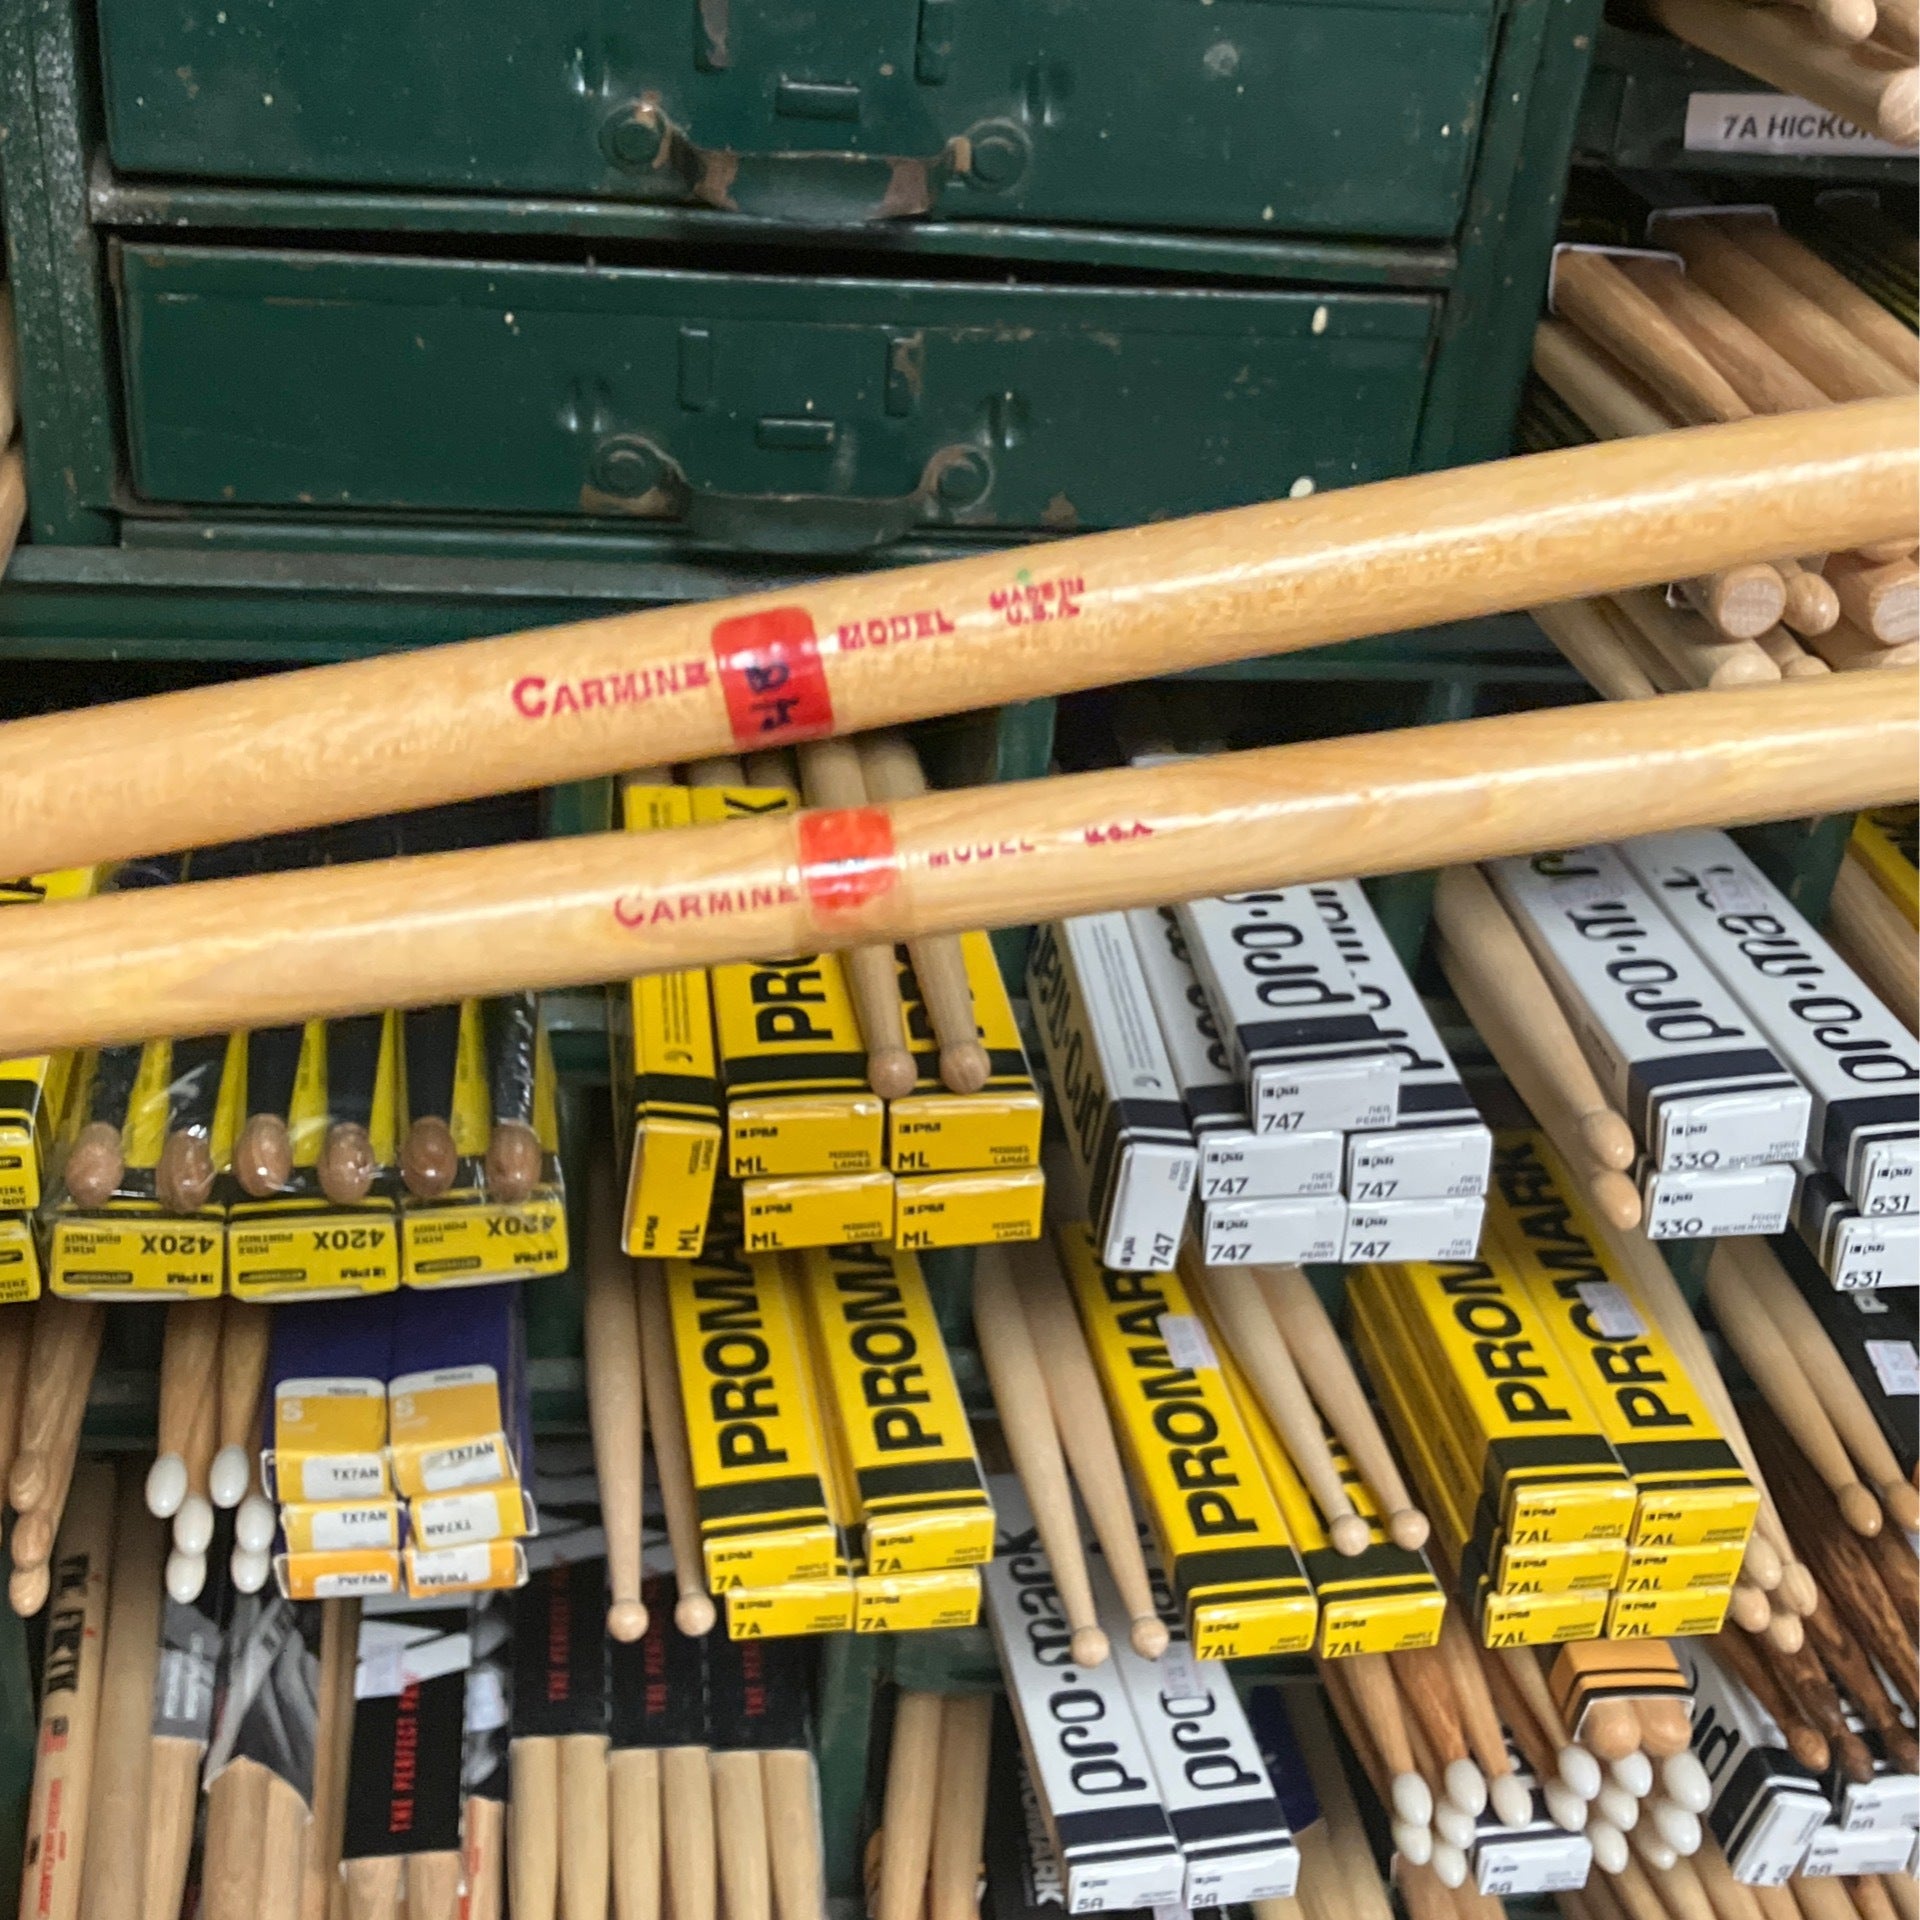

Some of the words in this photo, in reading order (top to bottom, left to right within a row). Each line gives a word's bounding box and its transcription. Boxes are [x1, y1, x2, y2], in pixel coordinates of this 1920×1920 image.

[1723, 115, 1758, 138] 7A
[1767, 114, 1876, 138] HICKO
[838, 610, 955, 650] MODEL
[512, 659, 710, 720] CARMINE
[614, 886, 801, 929] CARMINE
[1262, 1112, 1304, 1132] 747
[735, 1156, 767, 1174] ML
[898, 1151, 929, 1168] ML
[1668, 1150, 1720, 1171] 330
[1206, 1177, 1248, 1195] 747
[1357, 1180, 1398, 1198] 747
[1870, 1195, 1910, 1215] 531
[486, 1215, 556, 1237] 420X
[1653, 1217, 1703, 1238] 330
[141, 1234, 214, 1255] 420X
[313, 1228, 385, 1250] 420X
[677, 1225, 700, 1251] ML
[751, 1231, 782, 1247] ML
[903, 1231, 934, 1247] ML
[1148, 1233, 1174, 1267] 747
[1210, 1244, 1252, 1261] 747
[1350, 1241, 1391, 1258] 747
[1843, 1270, 1882, 1289] 531
[688, 1232, 788, 1468] PROMA
[826, 1245, 944, 1452] PROMA
[1430, 1258, 1573, 1424] PROM
[449, 1442, 495, 1461] TX7AN
[332, 1467, 379, 1480] TX7AN
[341, 1511, 388, 1524] TX7AN
[426, 1519, 472, 1536] TX7AN
[1515, 1529, 1552, 1543] 7AL
[1640, 1534, 1675, 1547] 7AL
[875, 1558, 903, 1572] 7A
[715, 1575, 743, 1590] 7A
[1507, 1581, 1542, 1594] 7AL
[1627, 1579, 1662, 1592] 7AL
[734, 1623, 761, 1636] 7A
[861, 1618, 888, 1630] 7A
[1616, 1623, 1652, 1637] 7AL
[1328, 1641, 1364, 1656] 7AL
[1491, 1632, 1528, 1648] 7AL
[1201, 1645, 1240, 1659] 7AL
